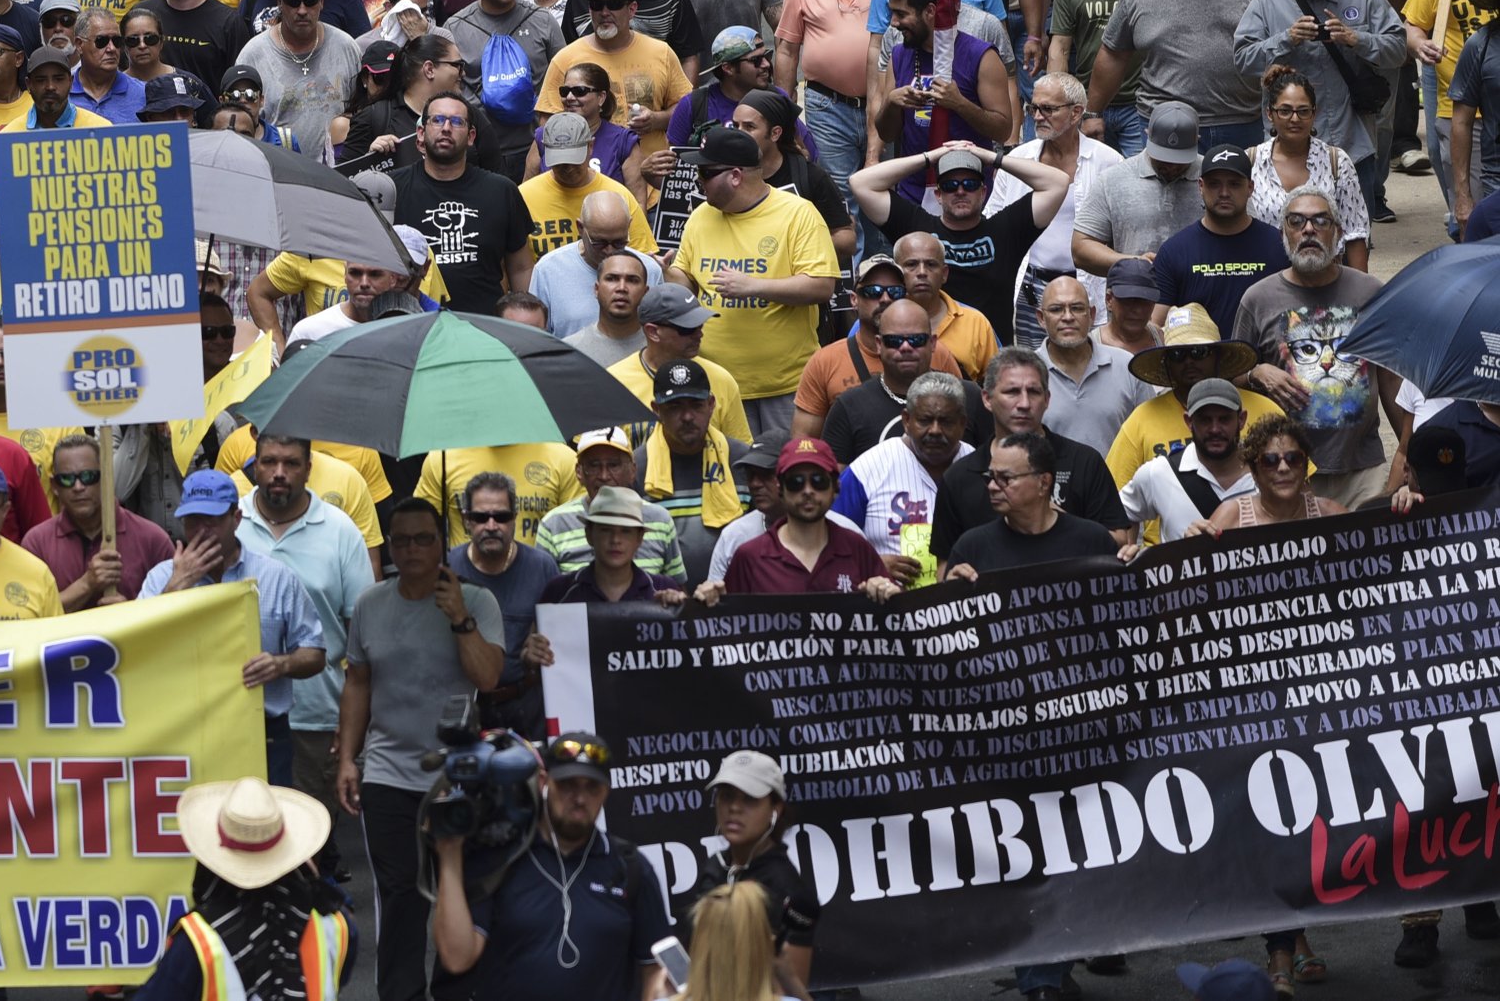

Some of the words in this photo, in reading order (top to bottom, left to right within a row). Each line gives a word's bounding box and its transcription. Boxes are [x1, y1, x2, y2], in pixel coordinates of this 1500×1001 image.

[11, 133, 172, 178] DEFENDAMOS
[30, 170, 157, 211] NUESTRAS
[664, 190, 682, 200] las
[28, 204, 164, 247] PENSIONES
[532, 219, 573, 237] SER
[44, 244, 111, 281] PARA
[117, 240, 153, 277] UN
[700, 257, 768, 274] FIRMES
[1193, 263, 1224, 274] POLO
[1225, 262, 1267, 272] SPORT
[14, 278, 101, 318] RETIRO
[109, 273, 186, 313] DIGNO
[73, 347, 136, 369] PRO
[73, 367, 138, 391] SOL
[76, 387, 139, 402] UTIER
[188, 487, 213, 497] Jeep
[607, 648, 683, 672] SALUD
[690, 647, 705, 668] Y
[711, 633, 835, 668] EDUCACIÓN
[843, 637, 905, 657] PARA
[912, 627, 981, 658] TODOS
[987, 606, 1086, 644] DEFENSA
[1092, 582, 1209, 625] DERECHOS
[1214, 553, 1393, 601] DEMOCRÁTICOS
[1400, 540, 1478, 573] APOYO
[636, 621, 663, 643] 30
[672, 620, 690, 641] K
[694, 612, 802, 639] DESPIDOS
[809, 612, 843, 632] NO
[849, 613, 879, 633] AL
[885, 591, 1002, 633] GASODUCTO
[1008, 580, 1082, 610] APOYO
[1089, 573, 1139, 597] UPR
[1144, 563, 1174, 589] NO
[1180, 557, 1207, 581] AL
[1212, 535, 1327, 574] DESALOJO
[1333, 529, 1366, 552] NO
[744, 664, 831, 693] CONTRA
[837, 661, 948, 684] AUMENTO
[955, 649, 1019, 680] COSTO
[1024, 642, 1052, 667] DE
[1055, 631, 1110, 659] VIDA
[1116, 625, 1150, 649] NO
[1156, 622, 1171, 643] A
[1175, 614, 1204, 638] LA
[1208, 593, 1333, 633] VIOLENCIA
[1337, 577, 1434, 611] CONTRA
[1438, 572, 1471, 596] LA
[771, 686, 913, 720] RESCATEMOS
[922, 677, 1026, 708] NUESTRO
[1029, 656, 1126, 696] TRABAJO
[1132, 651, 1165, 675] NO
[1171, 647, 1185, 668] A
[1190, 638, 1233, 665] LOS
[1239, 618, 1355, 656] DESPIDOS
[1360, 615, 1393, 638] EN
[1401, 601, 1479, 632] APOYO
[626, 724, 781, 758] NEGOCIACIÓN
[789, 713, 902, 746] COLECTIVA
[909, 705, 1029, 734] TRABAJOS
[1034, 683, 1129, 724] SEGUROS
[1134, 680, 1150, 701] Y
[1156, 669, 1211, 699] BIEN
[1219, 642, 1396, 689] REMUNERADOS
[1402, 632, 1465, 662] PLAN
[778, 739, 906, 776] JUBILACIÓN
[912, 739, 944, 761] NO
[952, 739, 980, 759] AL
[987, 717, 1109, 757] DISCRIMEN
[1115, 711, 1143, 735] EN
[1150, 706, 1179, 729] EL
[1185, 690, 1277, 723] EMPLEO
[1284, 677, 1362, 709] APOYO
[1369, 675, 1385, 697] A
[1390, 669, 1422, 693] LA
[895, 771, 925, 793] DE
[929, 766, 957, 788] LA
[962, 743, 1120, 785] AGRICULTURA
[1125, 719, 1288, 763] SUSTENTABLE
[1293, 715, 1309, 736] Y
[1317, 712, 1334, 734] A
[1340, 703, 1384, 730] LOS
[1389, 685, 1500, 723] TRABAJA
[609, 758, 712, 790] RESPETO
[630, 789, 703, 817] APOYO
[637, 767, 1216, 927] POHIBIDO
[1310, 814, 1378, 904] La
[1392, 782, 1500, 890] Luch
